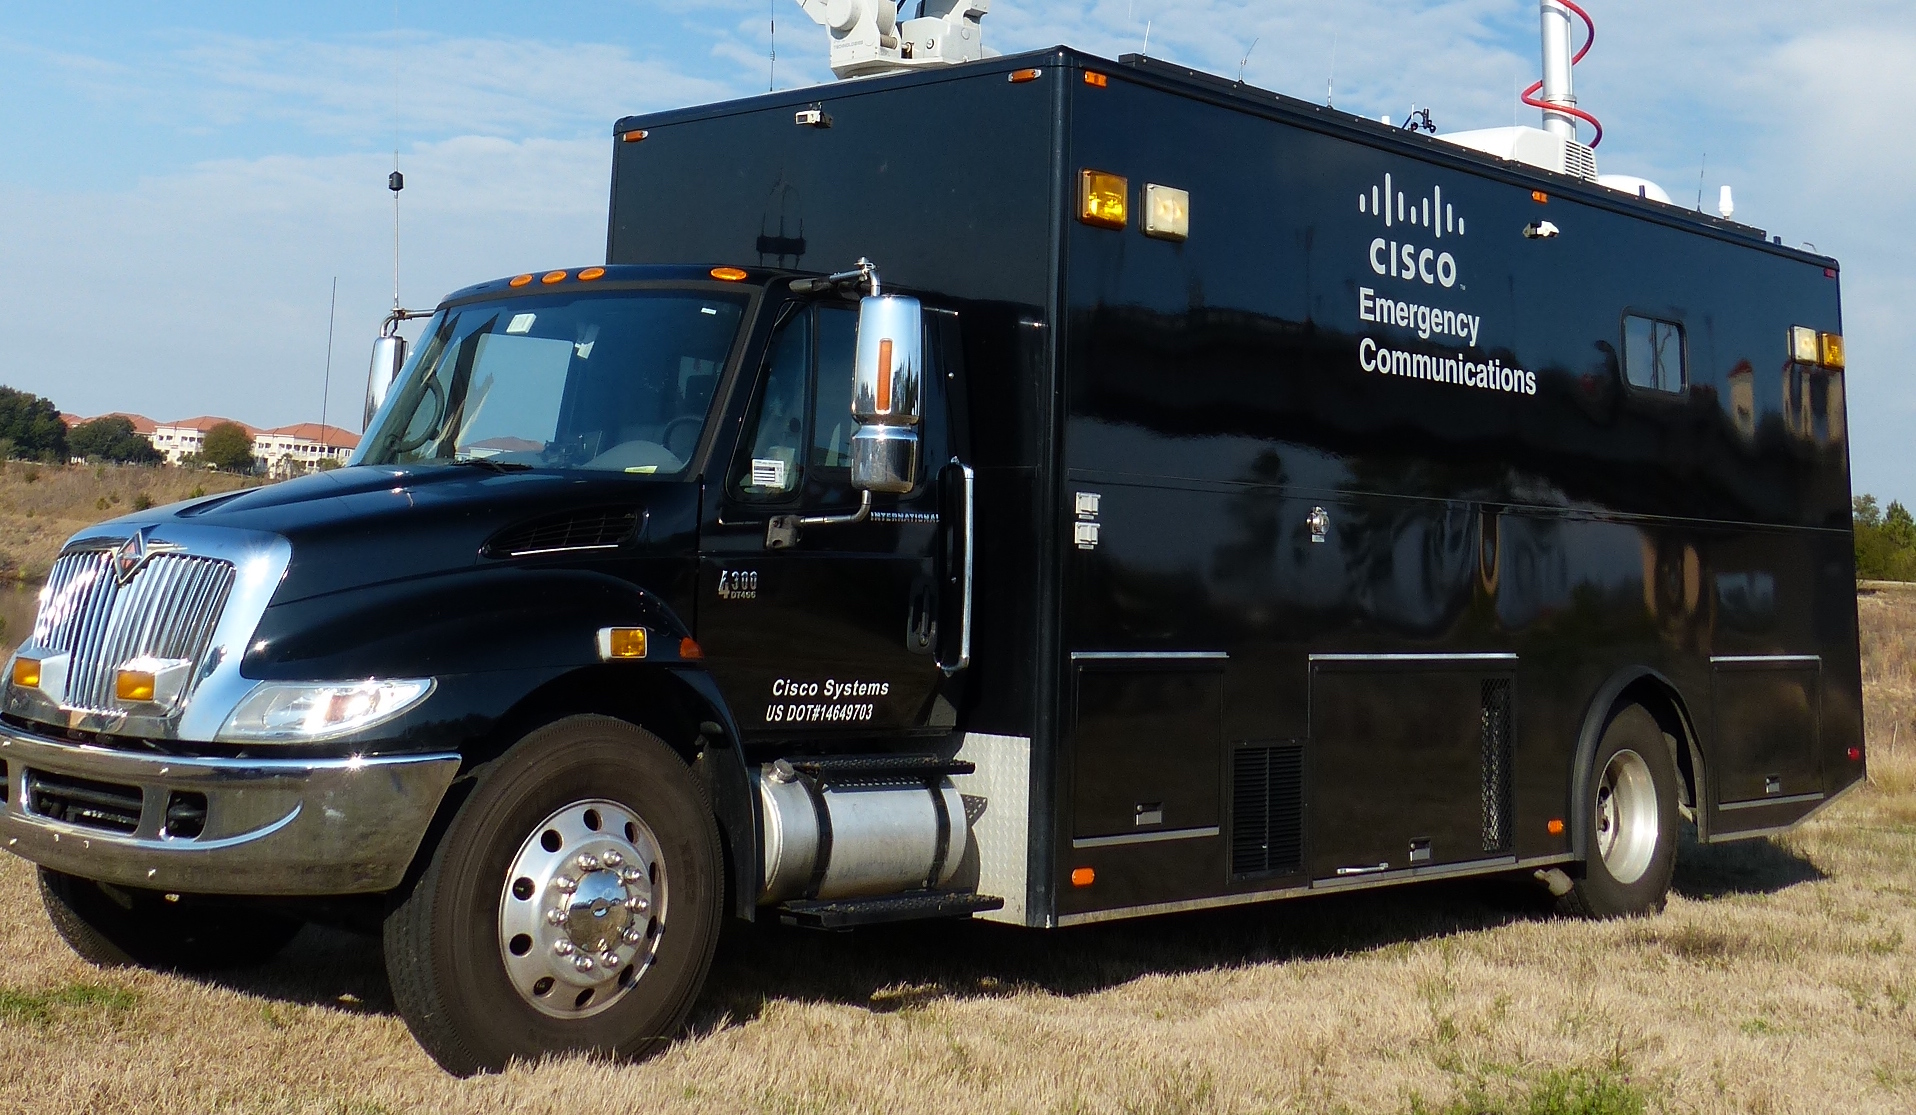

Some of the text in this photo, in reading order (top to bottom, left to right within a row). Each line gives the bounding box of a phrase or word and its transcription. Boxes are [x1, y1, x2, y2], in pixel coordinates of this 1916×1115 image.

[1369, 237, 1457, 288] CISCO
[1359, 286, 1481, 347] Emergency
[1359, 337, 1537, 396] Communications
[870, 511, 940, 523] INTERNATIONAL
[772, 679, 889, 700] Cisco Systems
[766, 703, 873, 722] US DOT#14649703
